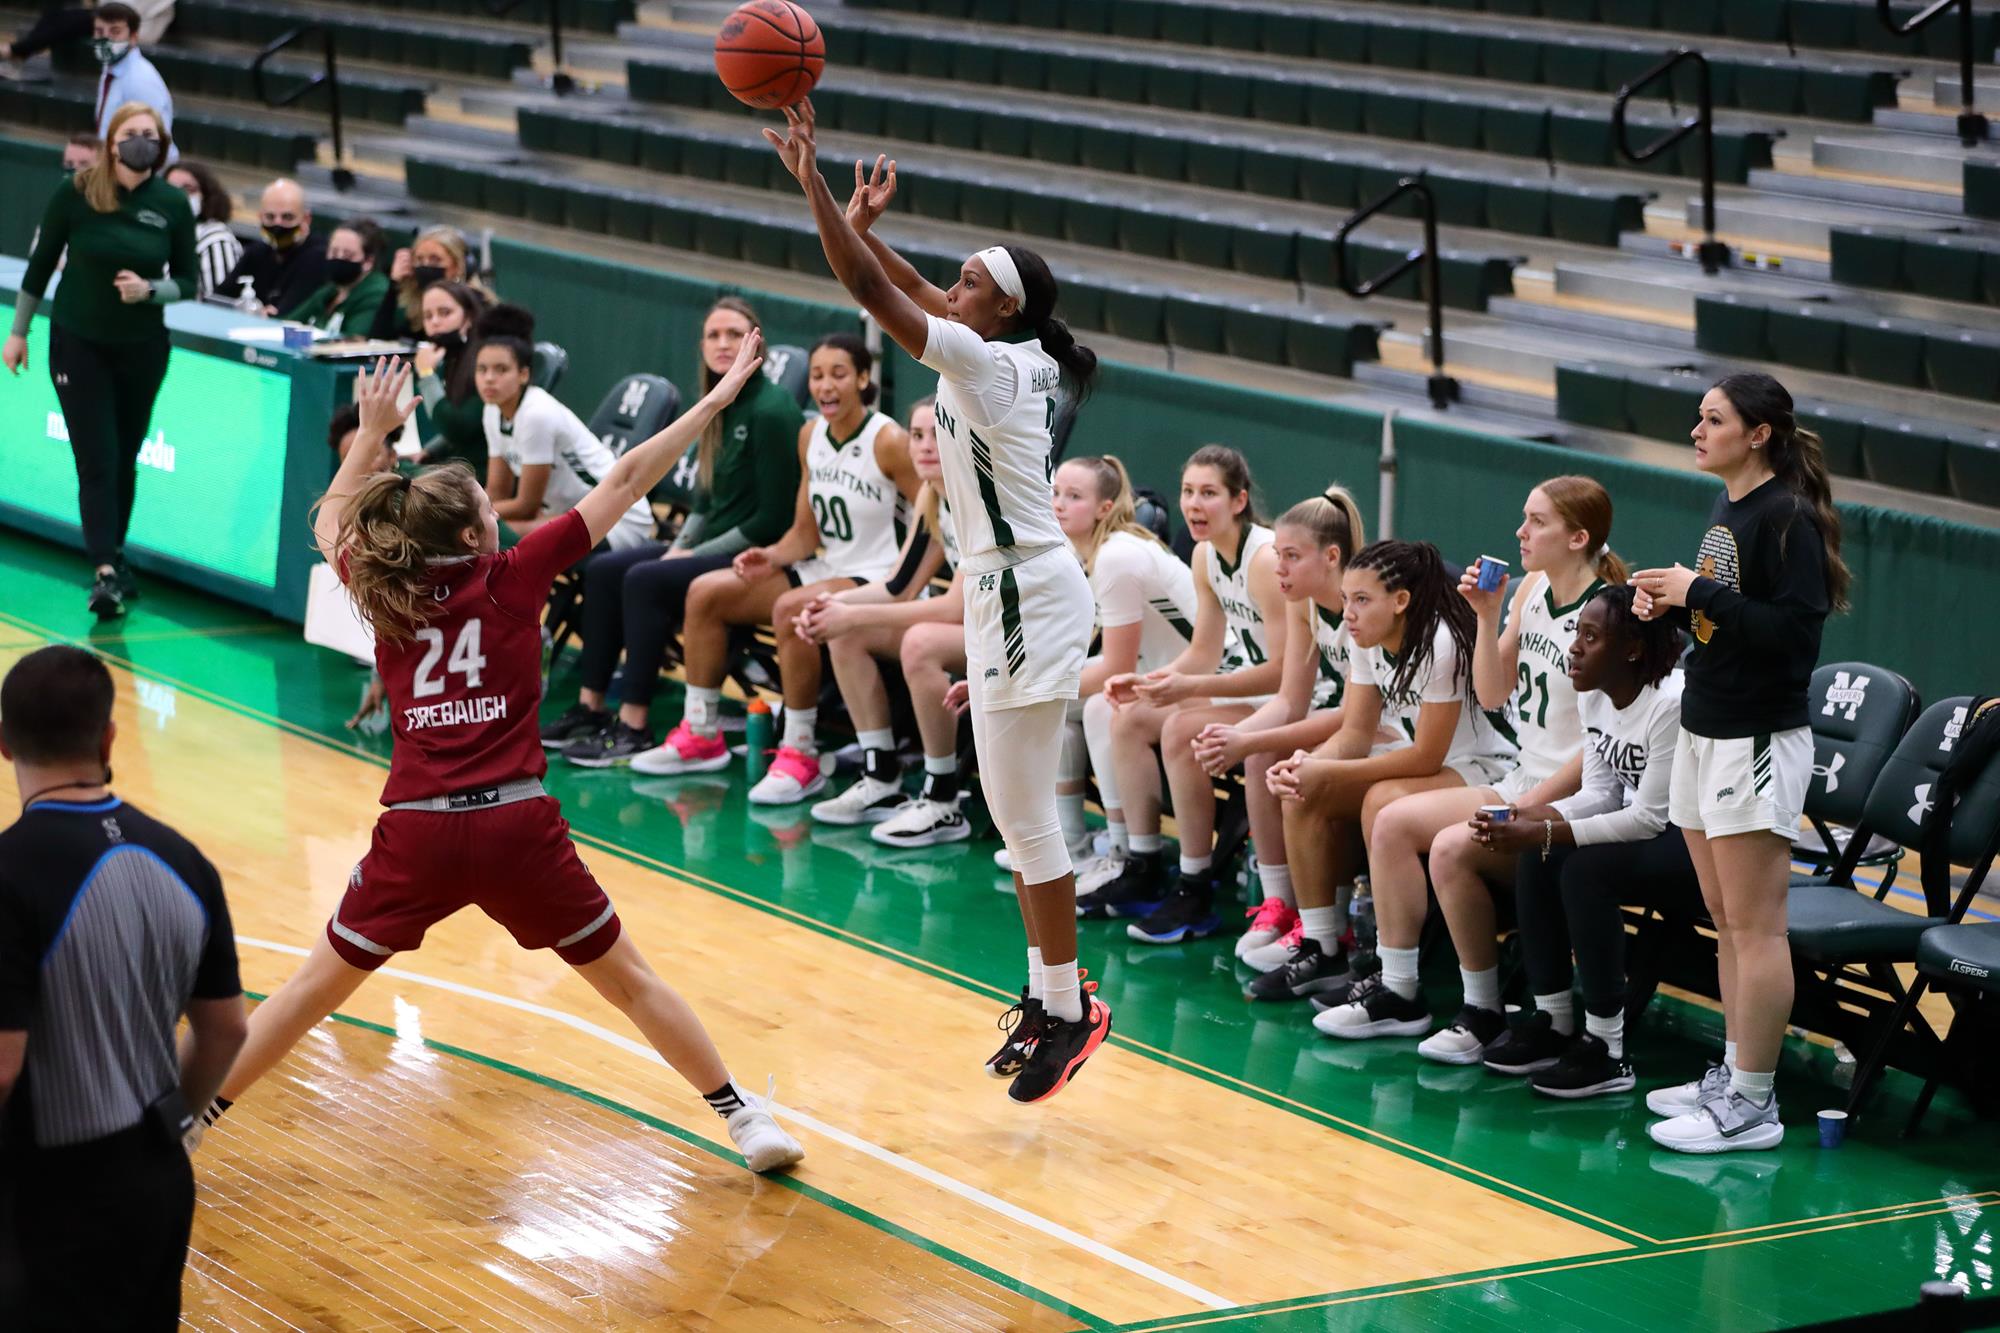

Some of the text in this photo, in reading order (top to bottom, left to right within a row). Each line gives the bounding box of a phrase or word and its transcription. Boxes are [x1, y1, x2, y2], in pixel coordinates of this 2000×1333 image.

[813, 494, 853, 542] 20
[413, 618, 487, 699] 24
[403, 695, 507, 731] FIREBAUGH
[1518, 662, 1549, 729] 21
[1950, 958, 1989, 978] JASPERS
